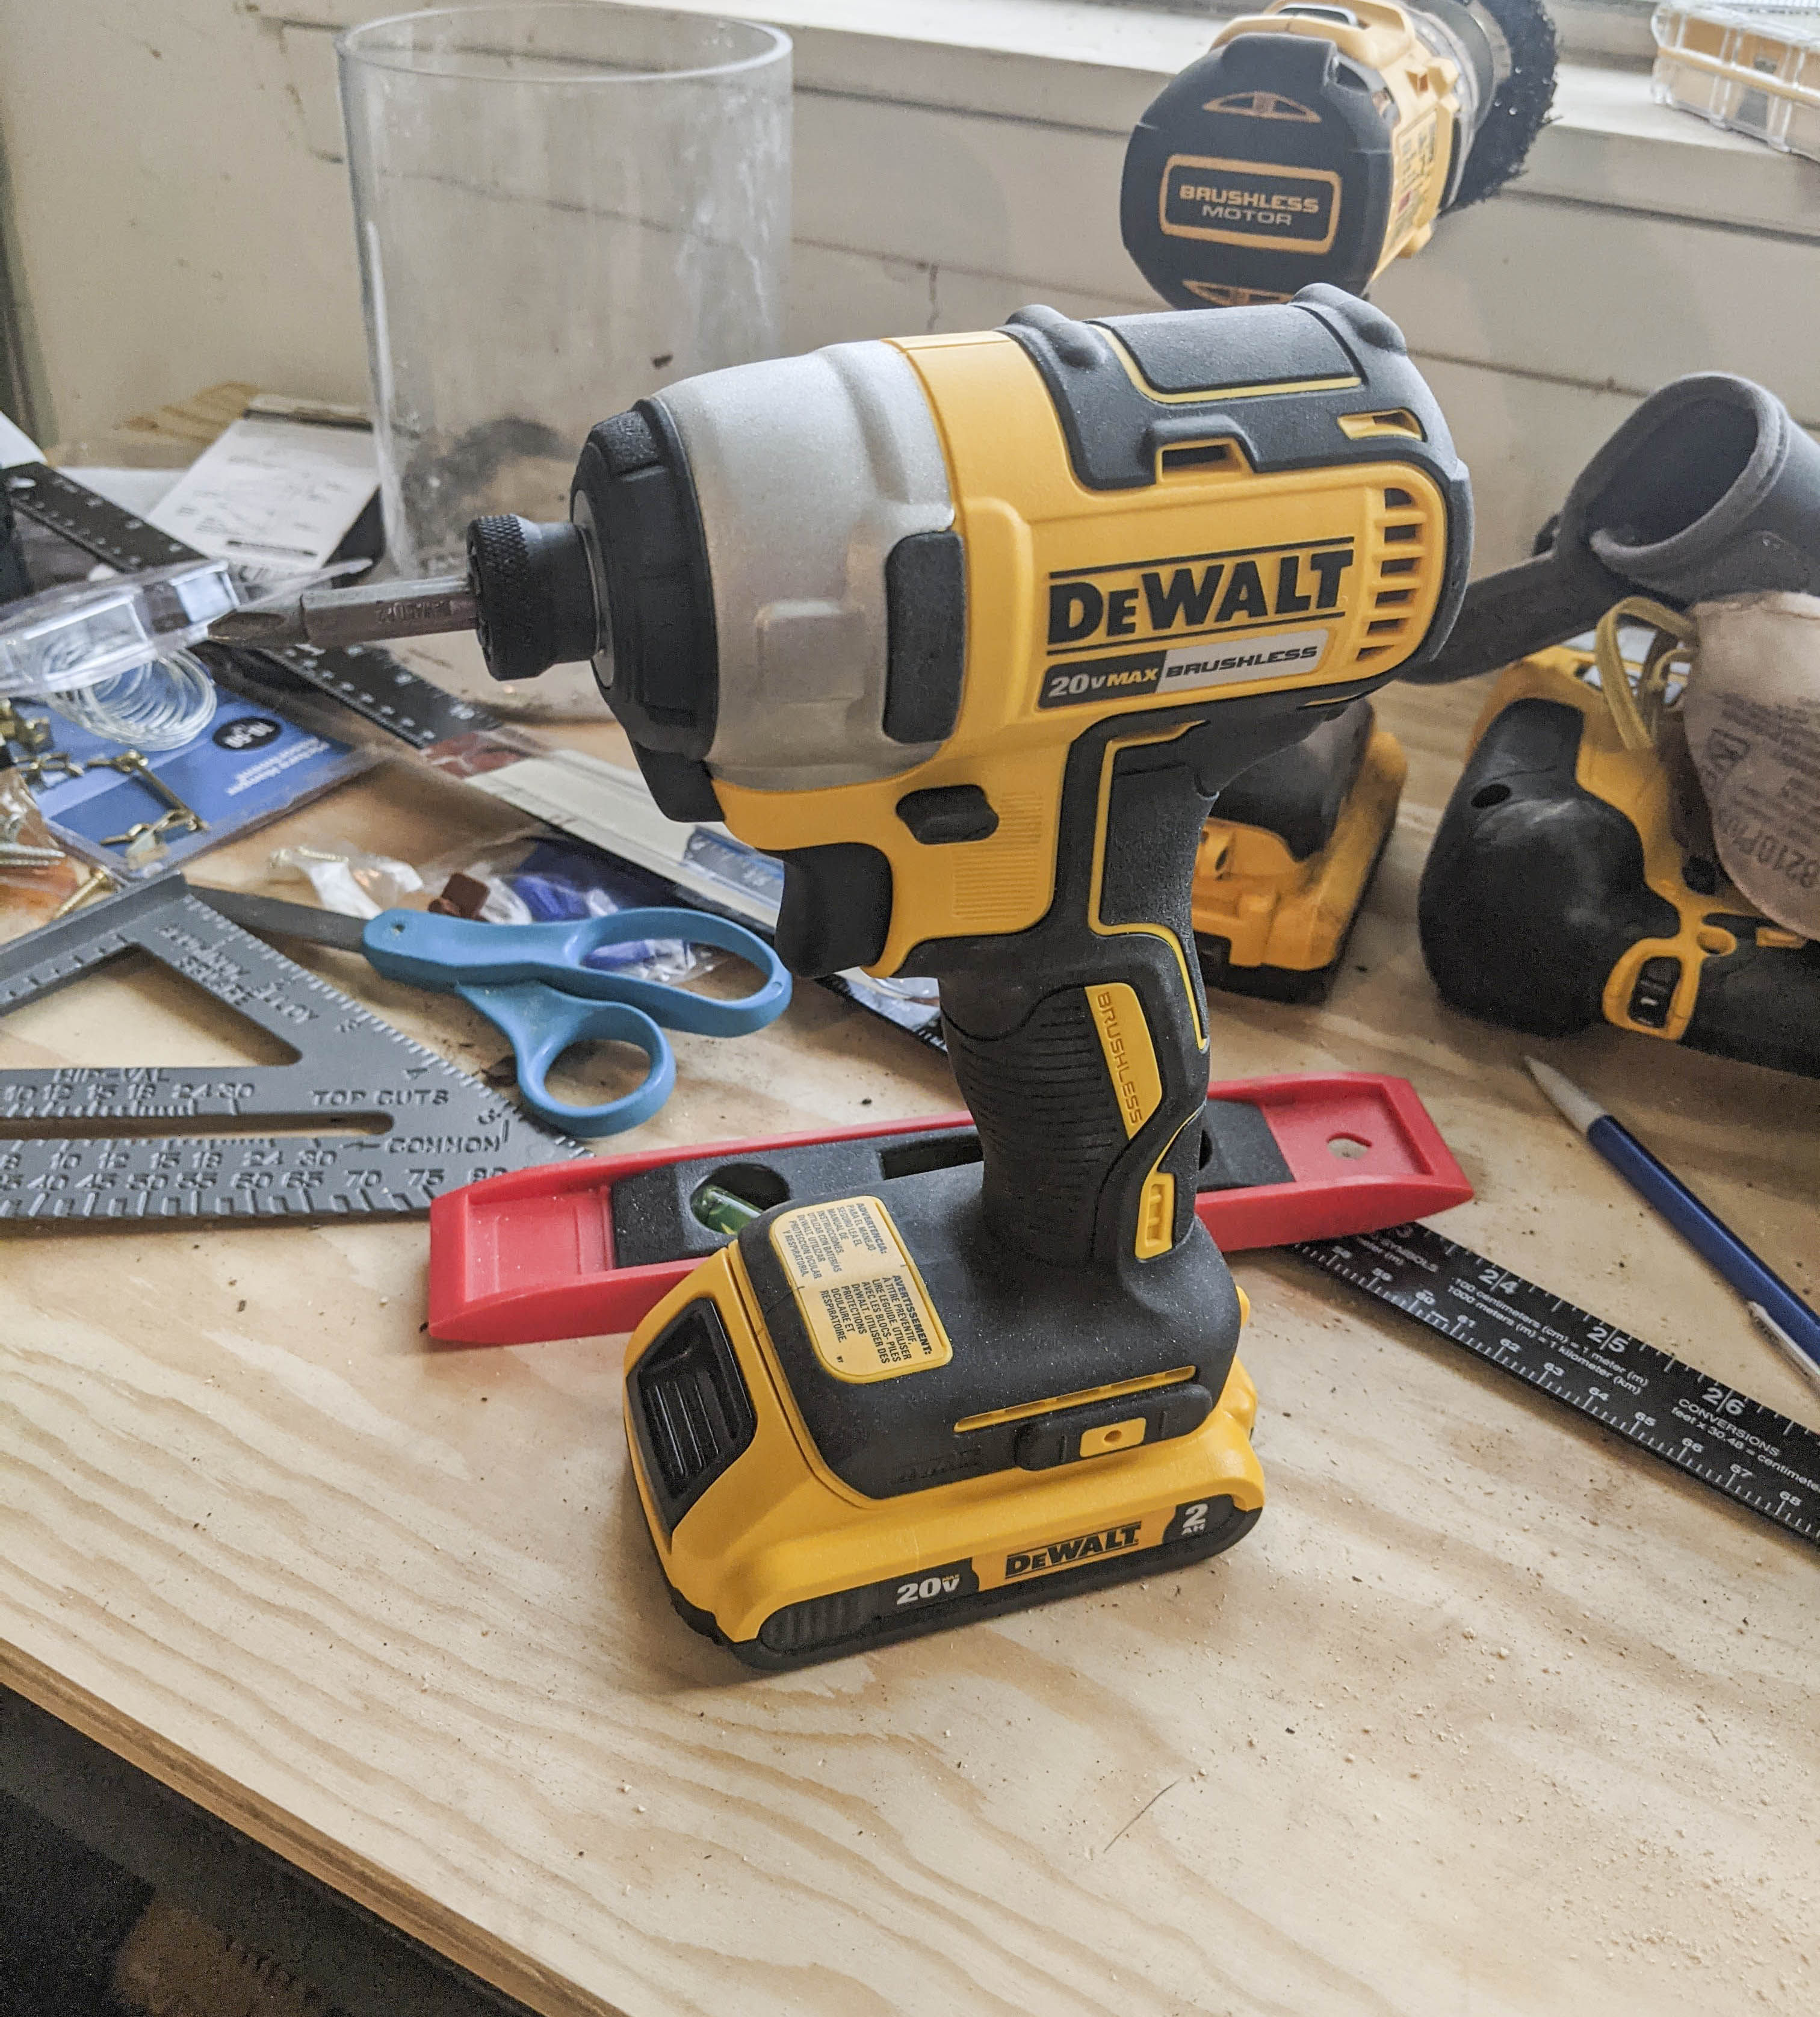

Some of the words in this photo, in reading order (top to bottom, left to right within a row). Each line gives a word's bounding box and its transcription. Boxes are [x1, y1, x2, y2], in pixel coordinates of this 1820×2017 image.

[1179, 184, 1319, 214] BRUSHLESS
[1202, 205, 1292, 226] MOTOR
[1165, 645, 1318, 679] BRUSHLESS
[1098, 991, 1143, 1125] BRUSHLESS
[311, 1089, 366, 1106] TOP
[376, 1089, 449, 1106] CUTS
[51, 1152, 81, 1170] 10
[386, 1136, 501, 1153] COMMON
[28, 1173, 69, 1190] 40
[75, 1173, 117, 1189] 45
[126, 1173, 168, 1189] 50
[176, 1173, 218, 1189] 55
[231, 1171, 274, 1188] 60
[282, 1170, 324, 1189] 65
[345, 1170, 383, 1186] 70
[407, 1168, 445, 1186] 75
[827, 1208, 844, 1232] MANUAL
[837, 1206, 853, 1228] SEGURO
[847, 1204, 859, 1219] PARA
[858, 1226, 876, 1251] MANEJO
[848, 1228, 859, 1239] LEA
[856, 1203, 887, 1254] ADVERTENCIA:
[808, 1237, 826, 1262] UTILIZAR
[819, 1235, 829, 1246] CON
[853, 1239, 862, 1247] EL
[805, 1256, 822, 1279] OCULAR
[831, 1288, 852, 1322] OCULAIRE
[845, 1324, 855, 1333] ET
[841, 1286, 867, 1334] PROTECTIONS
[885, 1283, 900, 1303] TITRE
[820, 1290, 847, 1343] RESPIRATOIRE.
[861, 1281, 876, 1300] AVEC
[870, 1300, 882, 1313] LES
[886, 1340, 901, 1362] PILES
[872, 1279, 884, 1294] LIRE
[892, 1327, 912, 1360] UTILISER
[893, 1275, 932, 1354] AVERTISSEMENT:
[1456, 1278, 1476, 1293] 100
[1476, 1290, 1541, 1329] centimeters
[1542, 1325, 1568, 1343] (cm)
[1592, 1352, 1626, 1373] meter
[1627, 1371, 1650, 1387] (m)
[864, 1315, 884, 1347] UTILISER
[878, 1347, 890, 1364] DES
[1448, 1285, 1476, 1304] 1000
[1475, 1302, 1515, 1326] meters
[1515, 1323, 1537, 1338] (m)
[1558, 1345, 1614, 1378] kilometer
[1613, 1375, 1642, 1396] (km)
[1478, 1268, 1518, 1294] 24
[1586, 1325, 1629, 1353] 25
[1702, 1387, 1745, 1415] 26
[1500, 1338, 1522, 1353] 62
[1544, 1362, 1564, 1377] 63
[1589, 1386, 1609, 1401] 64
[1635, 1411, 1656, 1427] 65
[1682, 1437, 1704, 1453] 66
[1730, 1464, 1753, 1477] 67
[1780, 1490, 1802, 1507] 68
[1678, 1398, 1780, 1457] CONVERSIONS
[1671, 1407, 1697, 1425] feet
[1707, 1426, 1744, 1449] 30.48
[1757, 1454, 1820, 1493] centimete
[1183, 1504, 1209, 1528] 2
